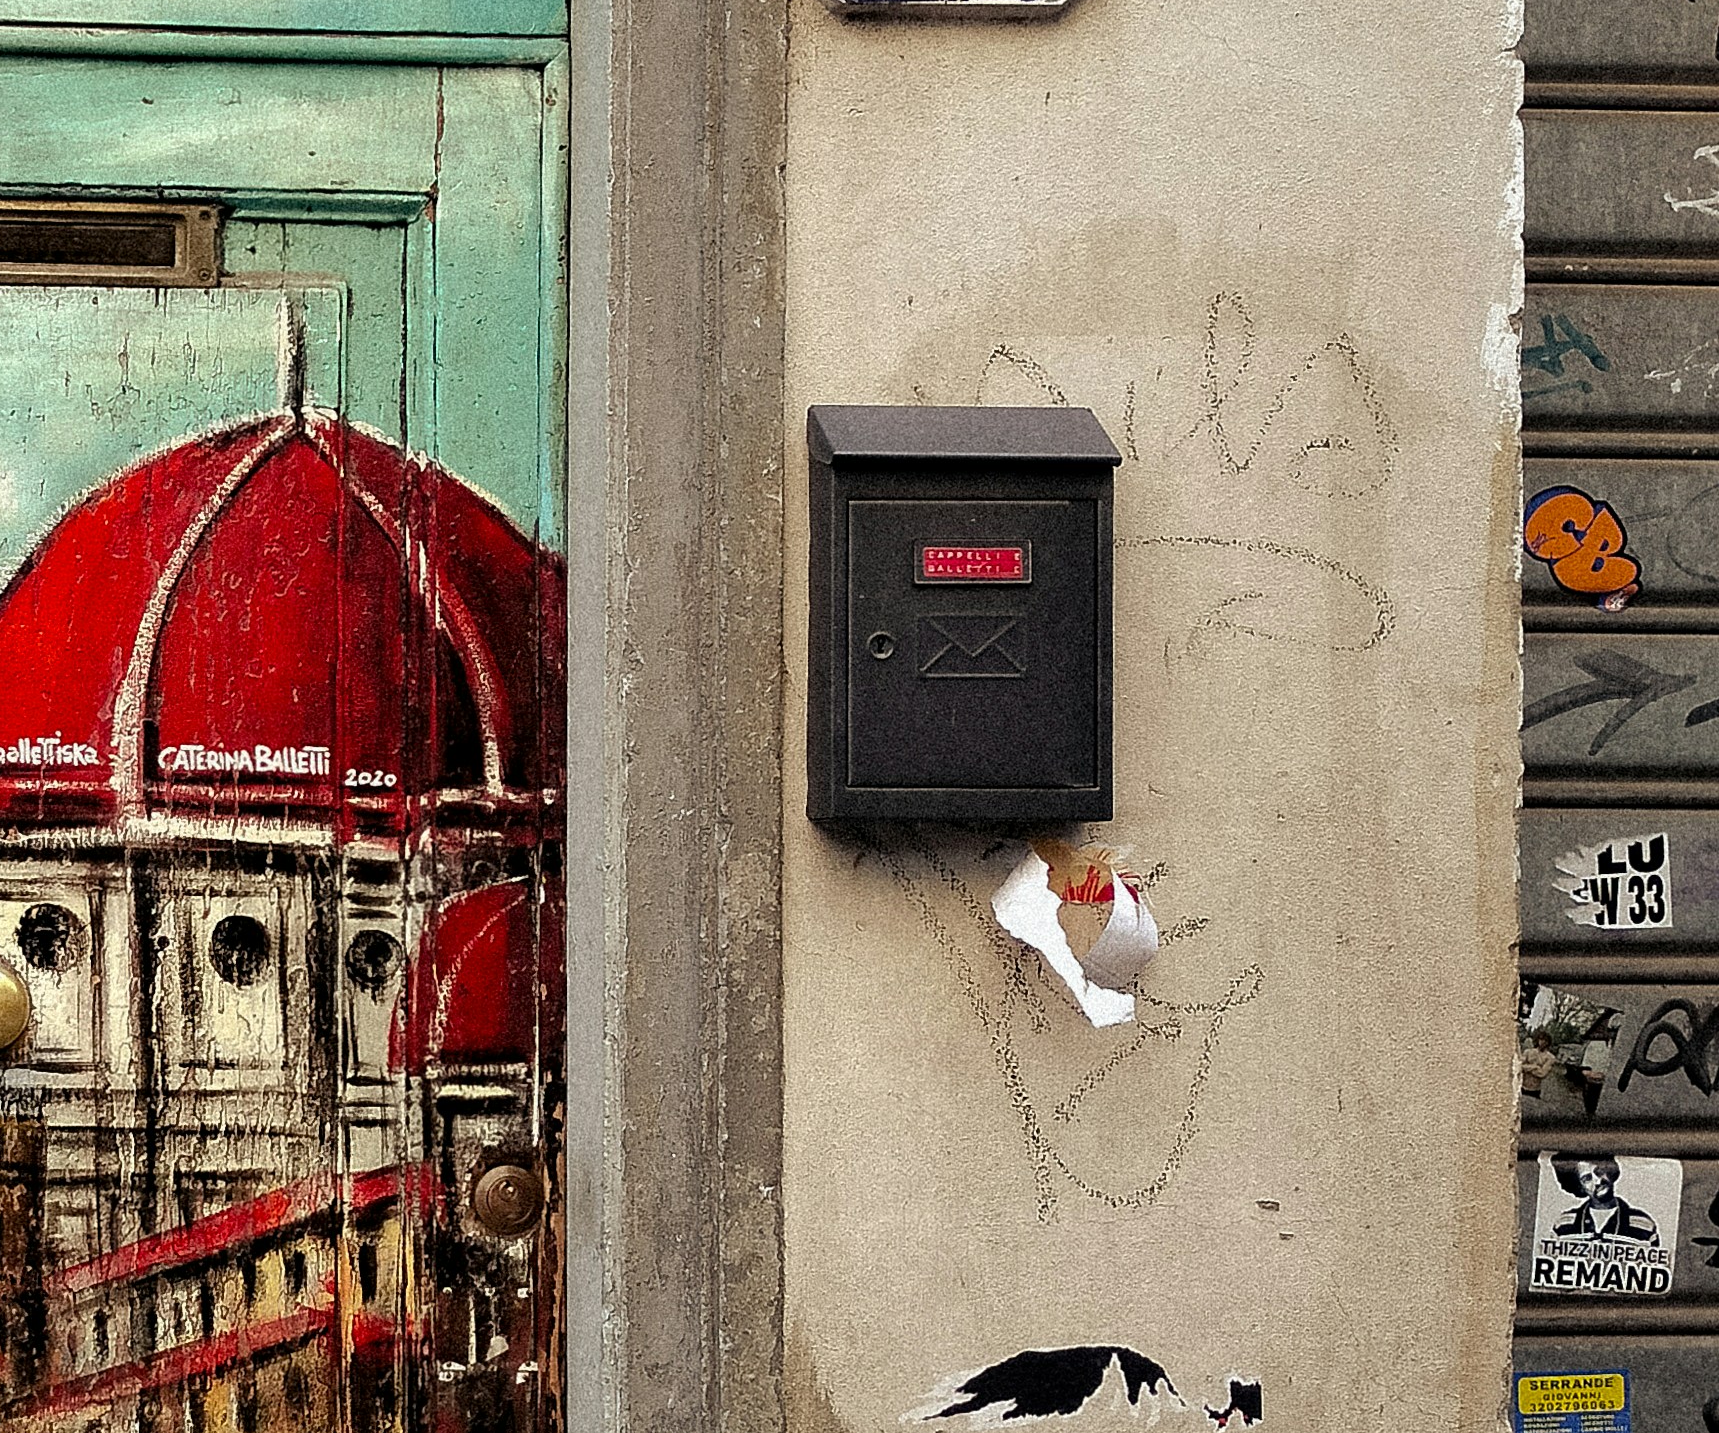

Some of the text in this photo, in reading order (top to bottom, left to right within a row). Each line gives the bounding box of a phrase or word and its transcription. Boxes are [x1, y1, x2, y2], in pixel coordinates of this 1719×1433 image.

[928, 551, 1000, 561] CAPPELLI
[928, 564, 1000, 573] BALLETTI
[344, 768, 398, 787] 2020
[1627, 874, 1665, 924] 33
[1541, 1239, 1668, 1264] THIZZ IN PEACE
[1533, 1257, 1670, 1293] REMAND
[1530, 1377, 1614, 1391] SERRANDE
[1543, 1392, 1601, 1401] GIOVANNI
